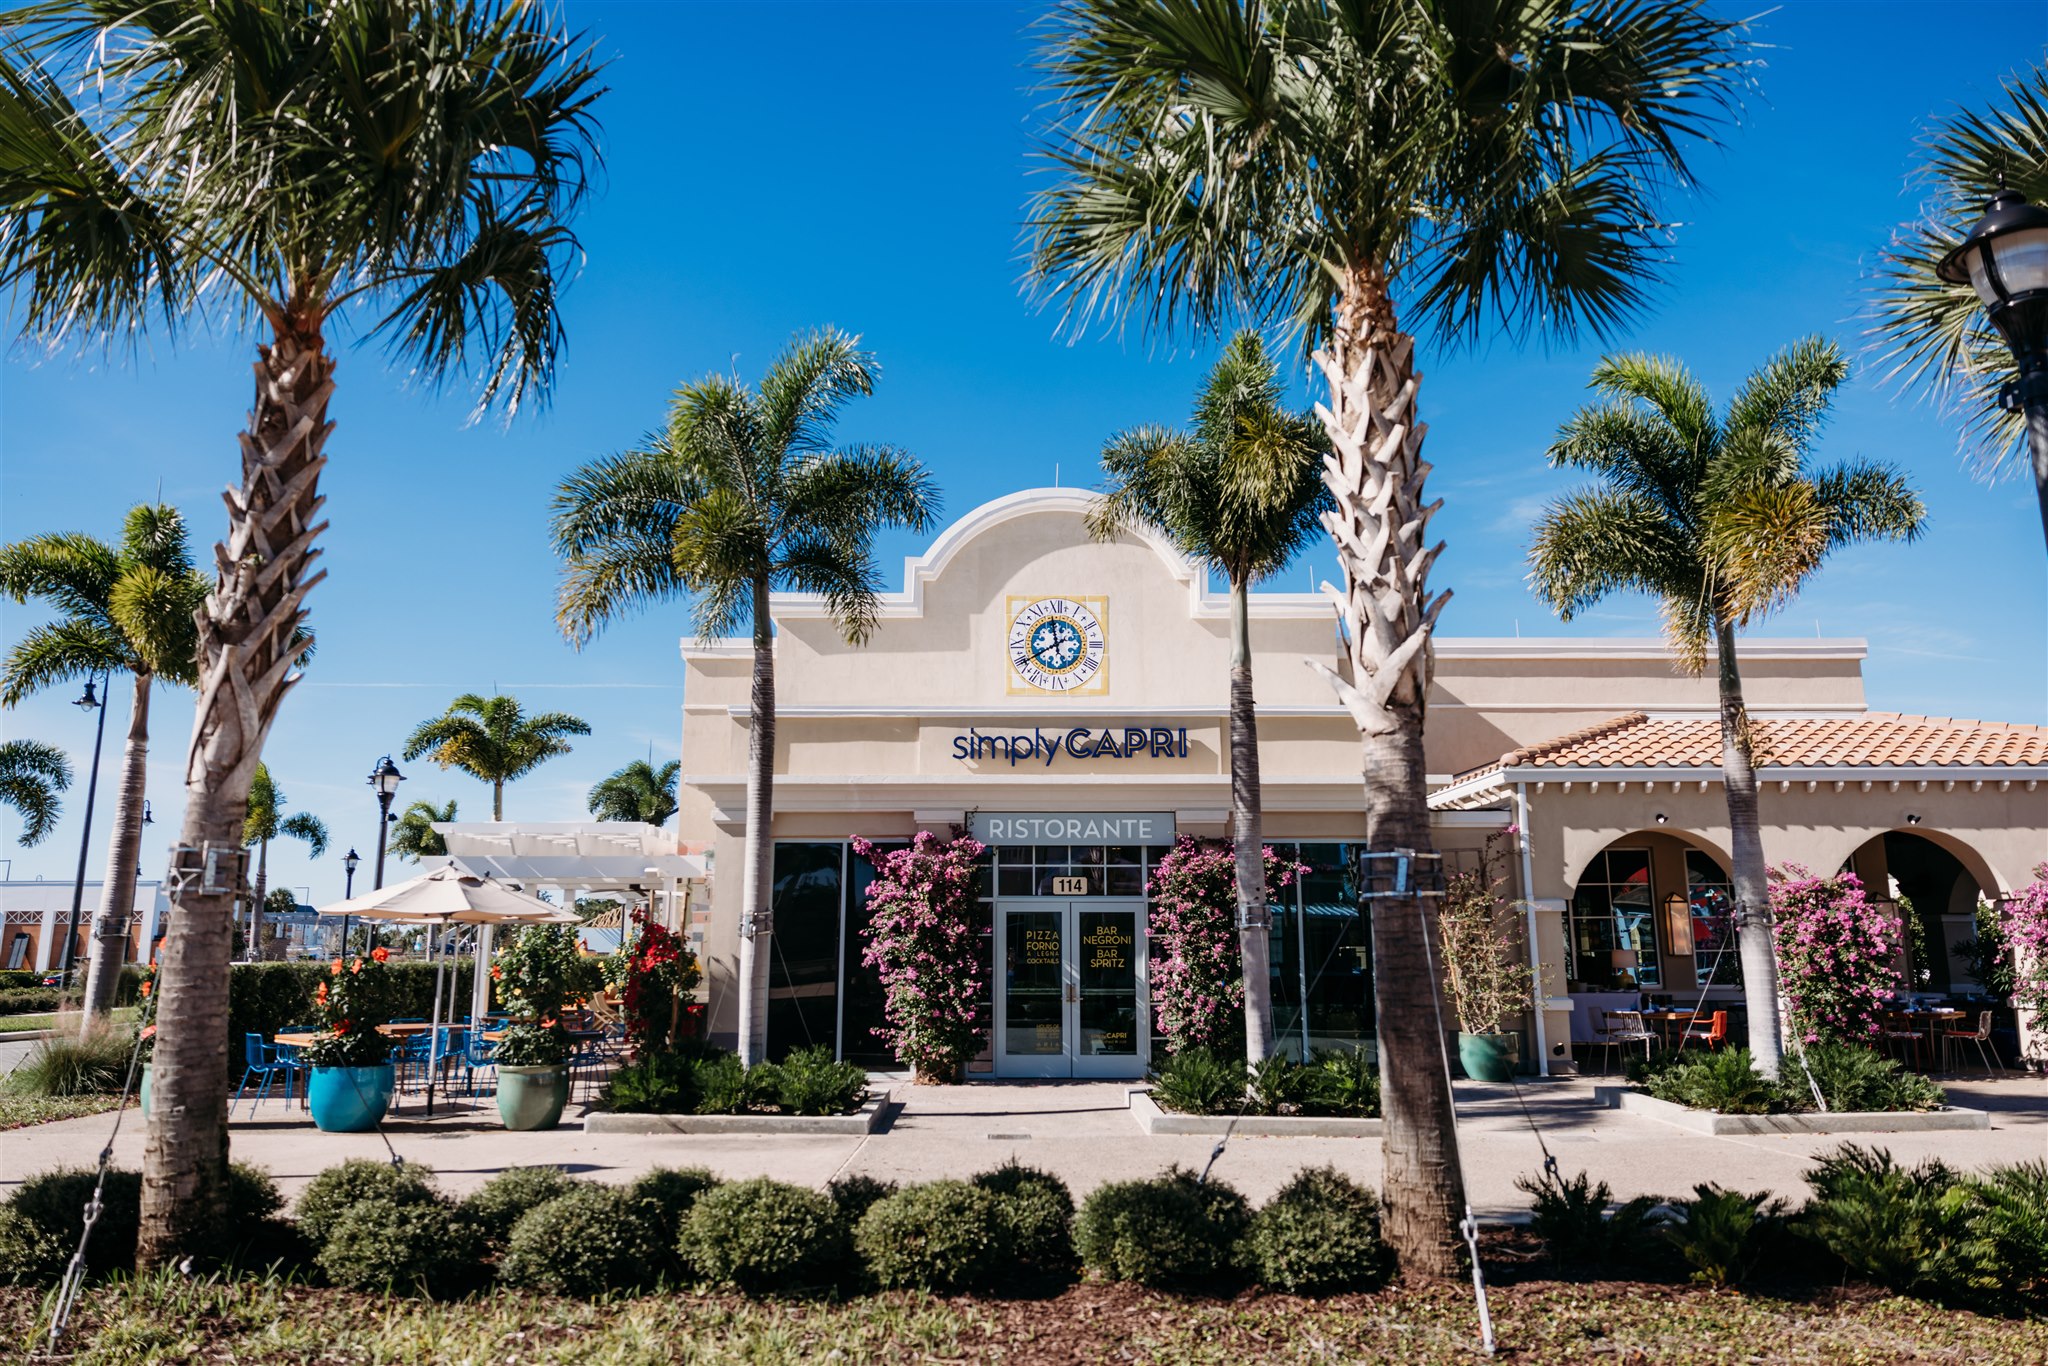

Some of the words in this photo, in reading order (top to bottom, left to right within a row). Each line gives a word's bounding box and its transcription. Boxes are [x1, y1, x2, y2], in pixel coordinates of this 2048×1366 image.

[989, 819, 1153, 839] RISTORANTE
[1058, 879, 1083, 892] 114
[1026, 930, 1060, 940] PIZZA
[1096, 926, 1118, 935] BAR
[1083, 935, 1132, 945] NEGRONI
[1026, 941, 1060, 951] FORNO
[1096, 949, 1118, 958] BAR
[1090, 958, 1125, 968] SPRITZ
